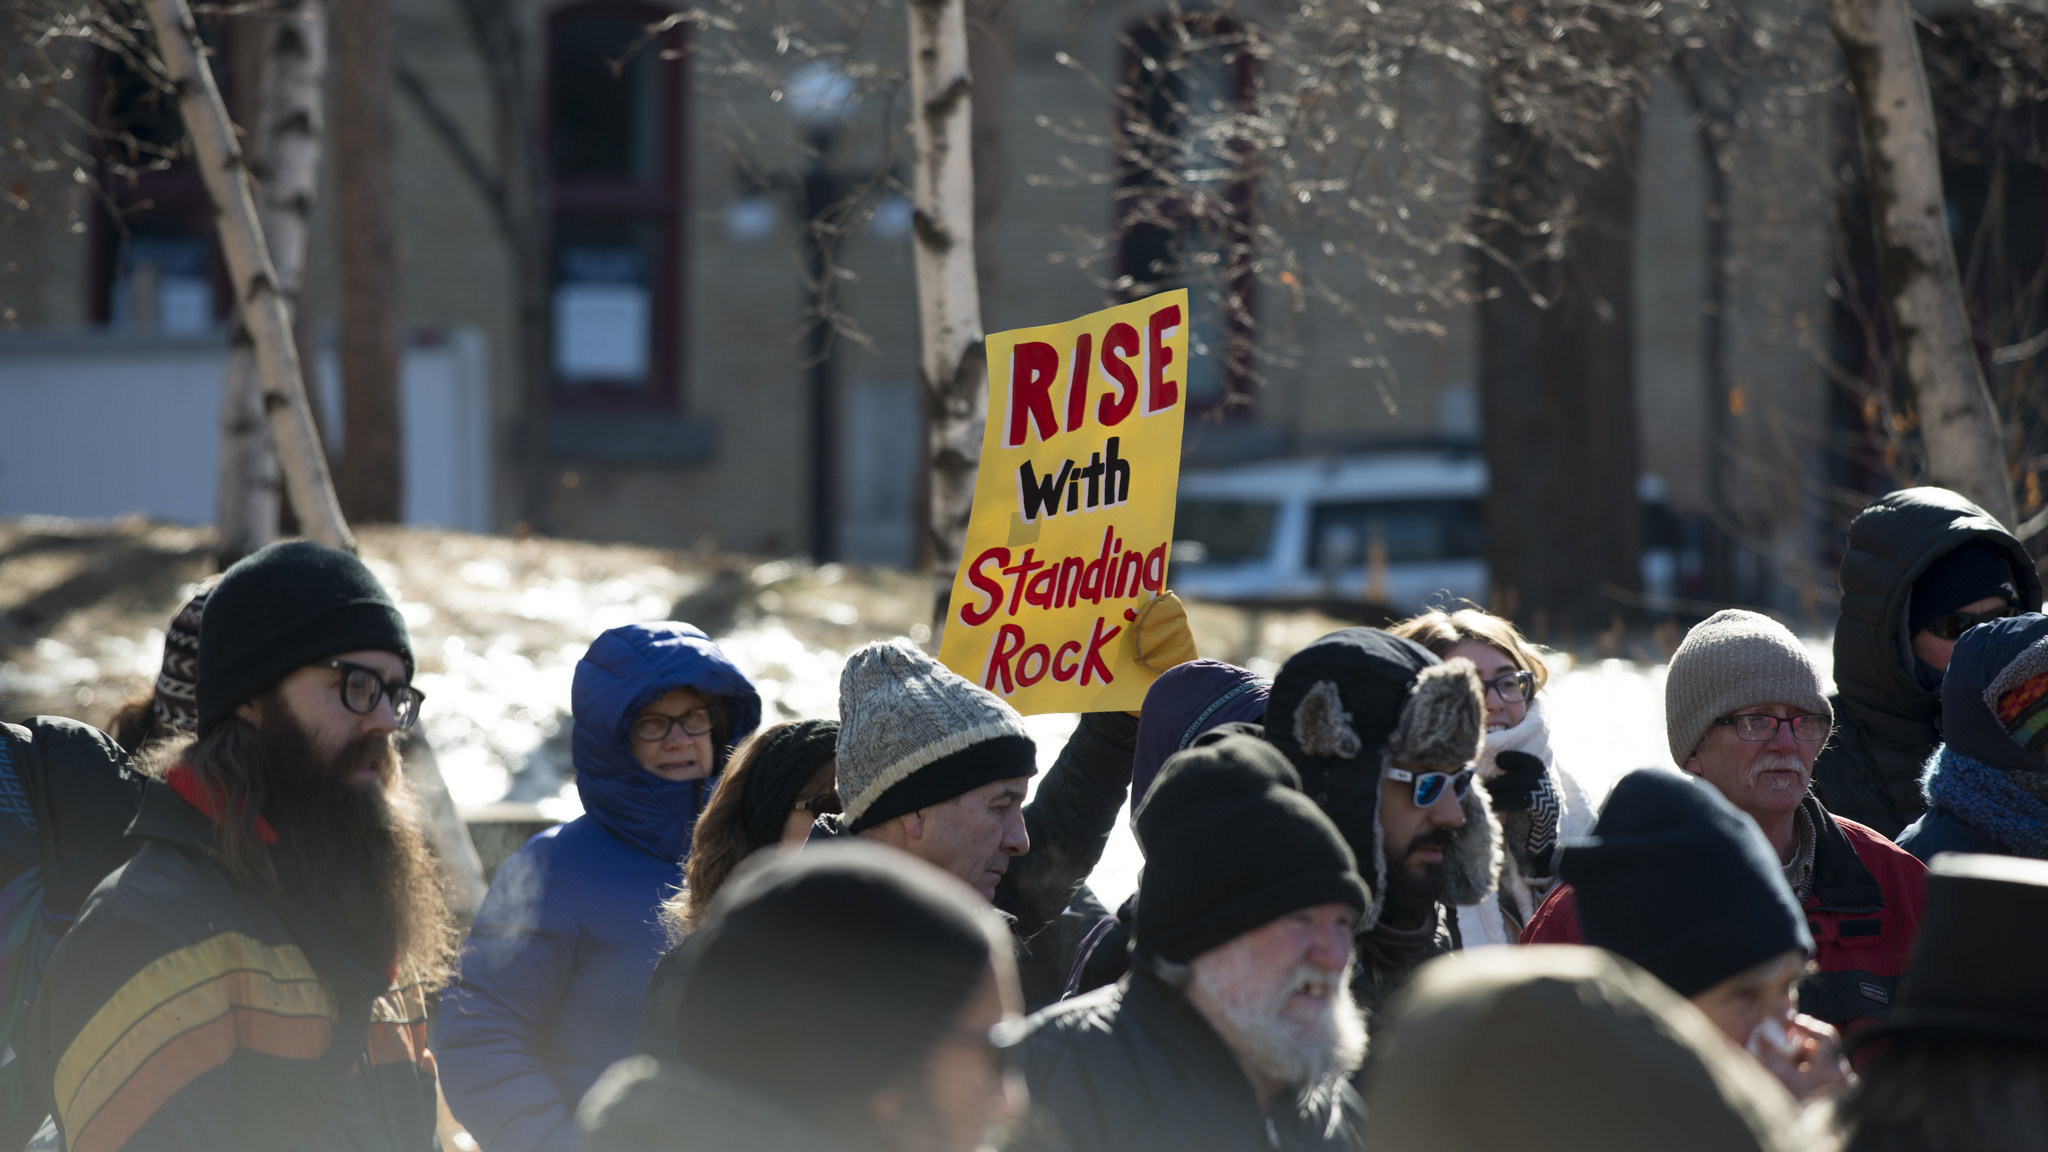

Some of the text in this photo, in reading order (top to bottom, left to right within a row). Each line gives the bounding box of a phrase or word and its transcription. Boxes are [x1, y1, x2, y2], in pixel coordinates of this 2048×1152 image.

[1003, 304, 1182, 448] RISE
[1016, 436, 1131, 523] With
[959, 525, 1168, 627] Standing
